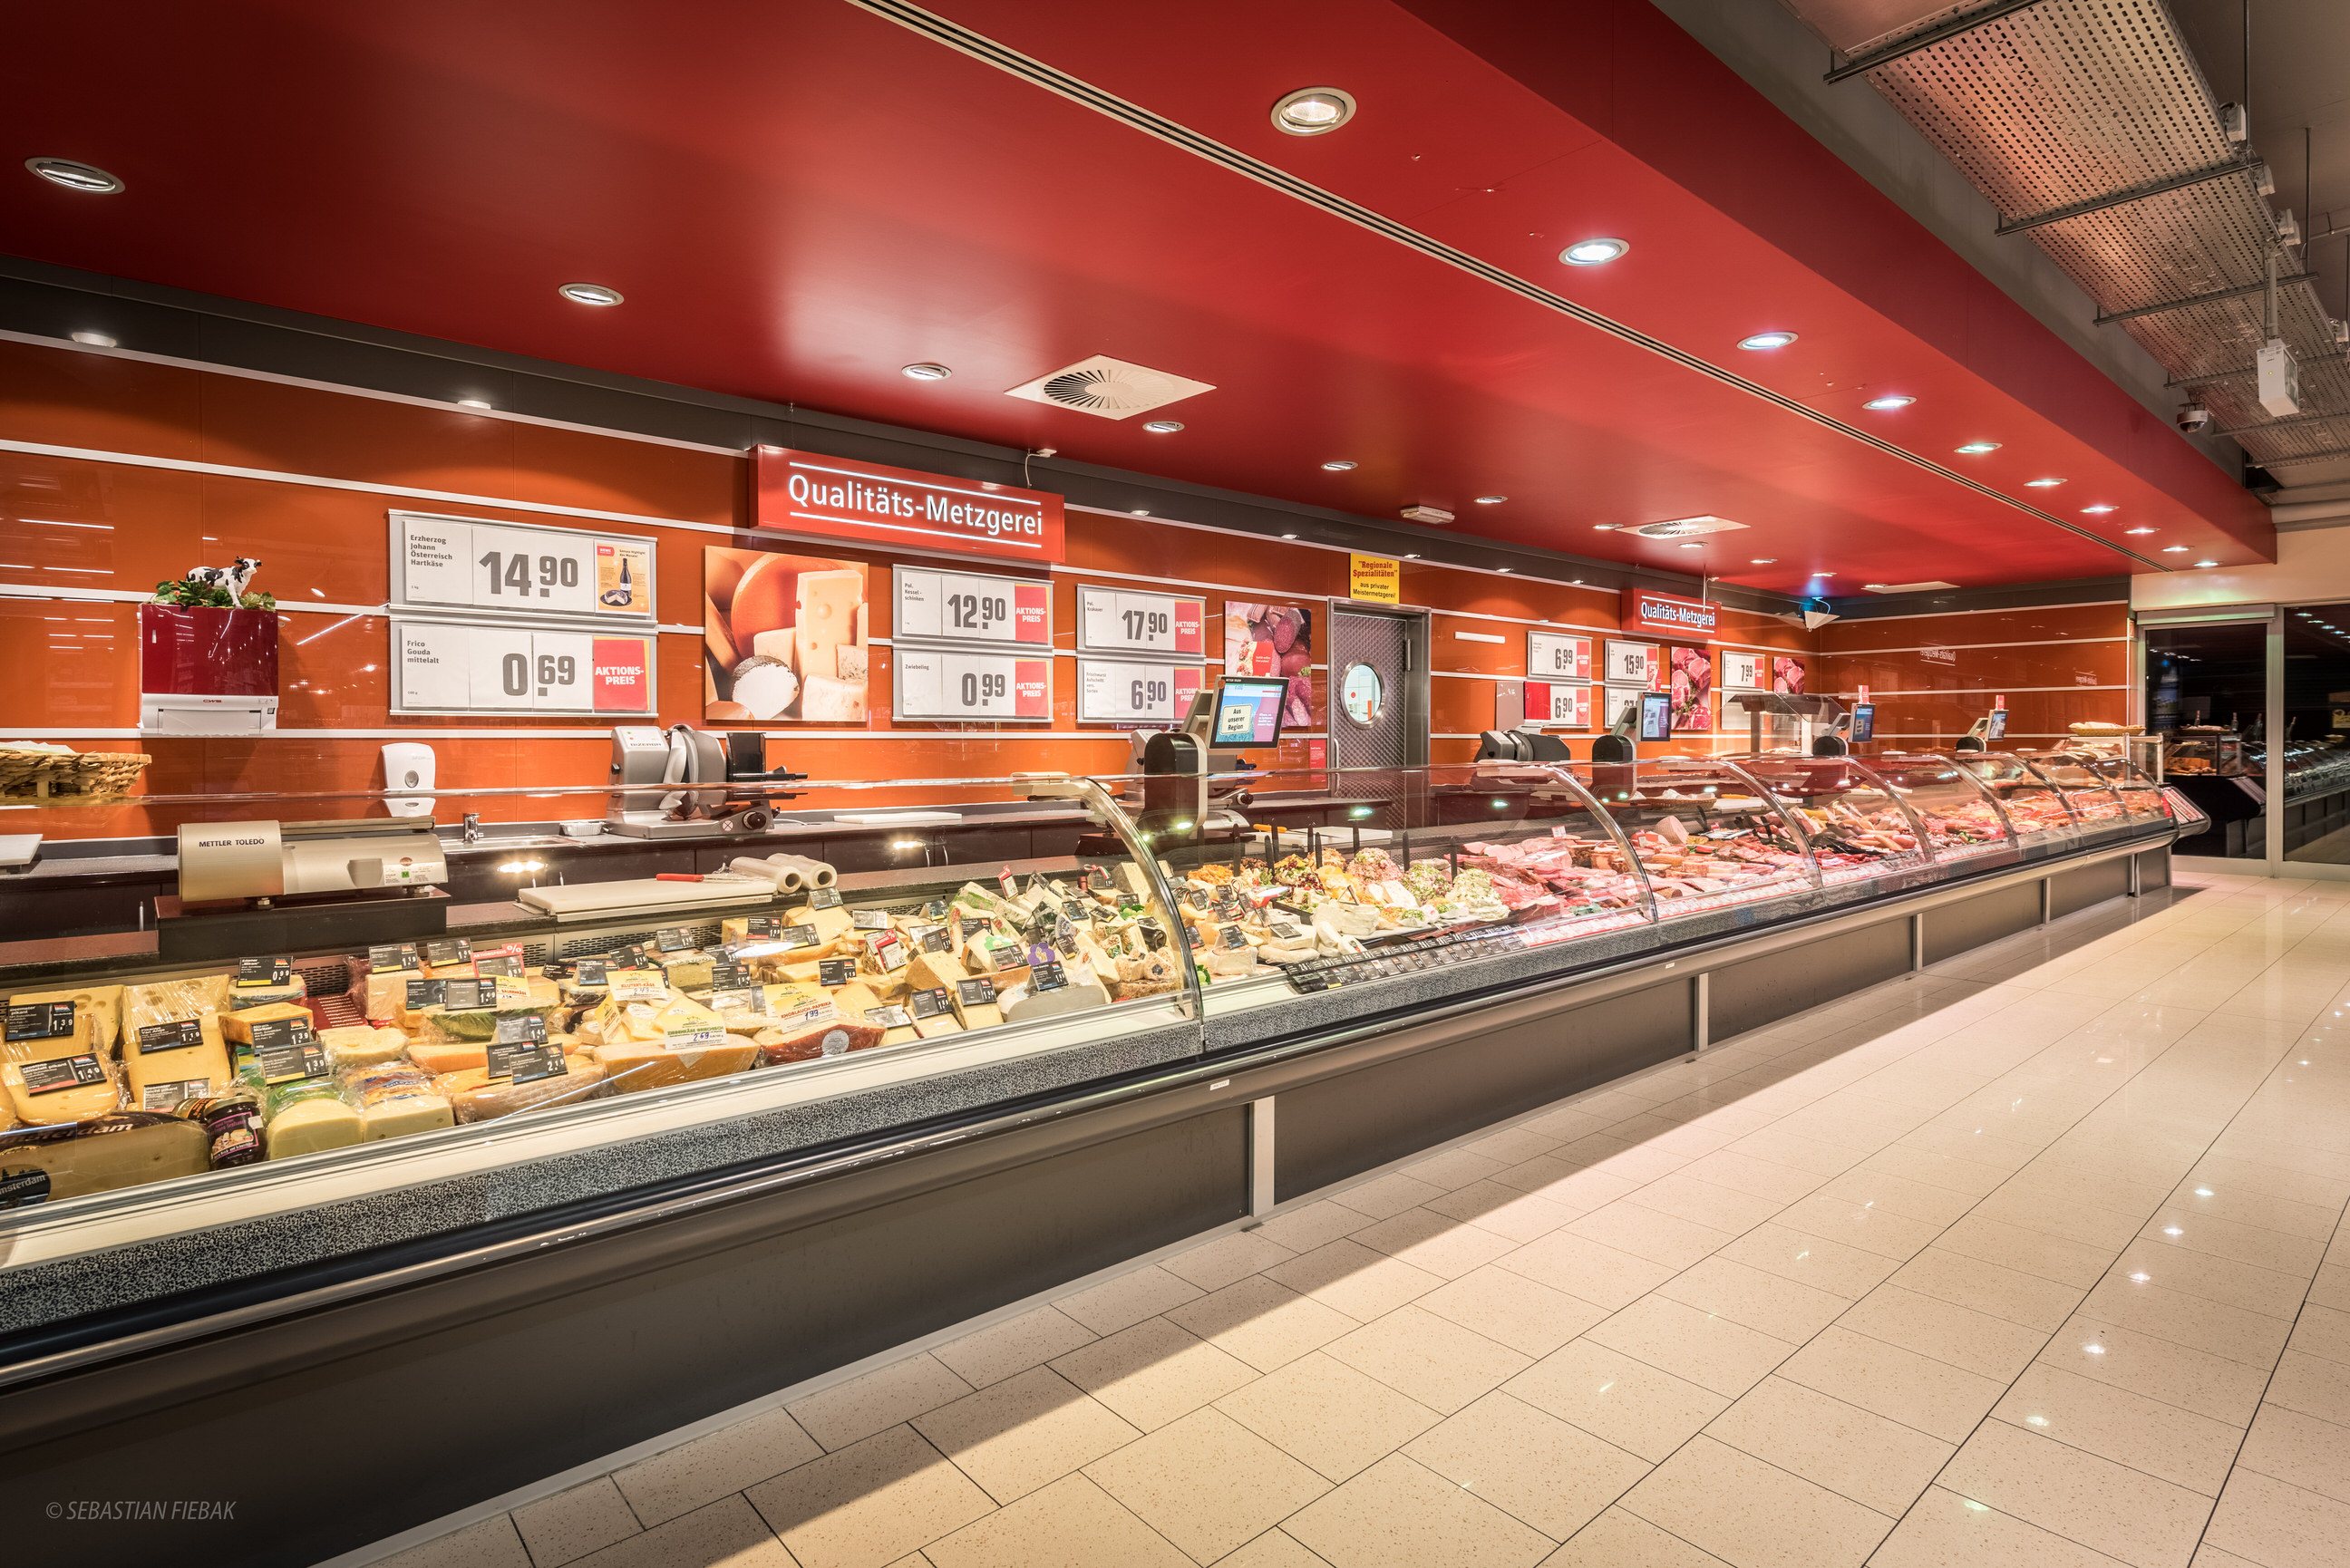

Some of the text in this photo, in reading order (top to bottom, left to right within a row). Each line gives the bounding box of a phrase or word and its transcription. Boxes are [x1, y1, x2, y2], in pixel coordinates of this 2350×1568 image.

[788, 474, 1043, 537] Qualitäts-Metzgerei
[410, 534, 447, 546] Erzherzog
[410, 543, 436, 551] Johann
[411, 549, 453, 560] Österreisch
[411, 559, 443, 567] Hartkäse
[1358, 560, 1393, 570] "Regionale
[1353, 569, 1398, 579] Spezialitäten"
[1015, 607, 1046, 615] AKTIONS-
[1640, 602, 1715, 627] Qualitäts-Metzgerei
[1022, 615, 1042, 623] PREIS
[595, 666, 645, 677] AKTIONS-
[605, 675, 636, 685] PREIS
[1015, 682, 1046, 691] AKTIONS-
[1022, 689, 1042, 698] PREIS
[199, 837, 265, 848] METTLER TOLEDO
[0, 1174, 45, 1195] msterdam
